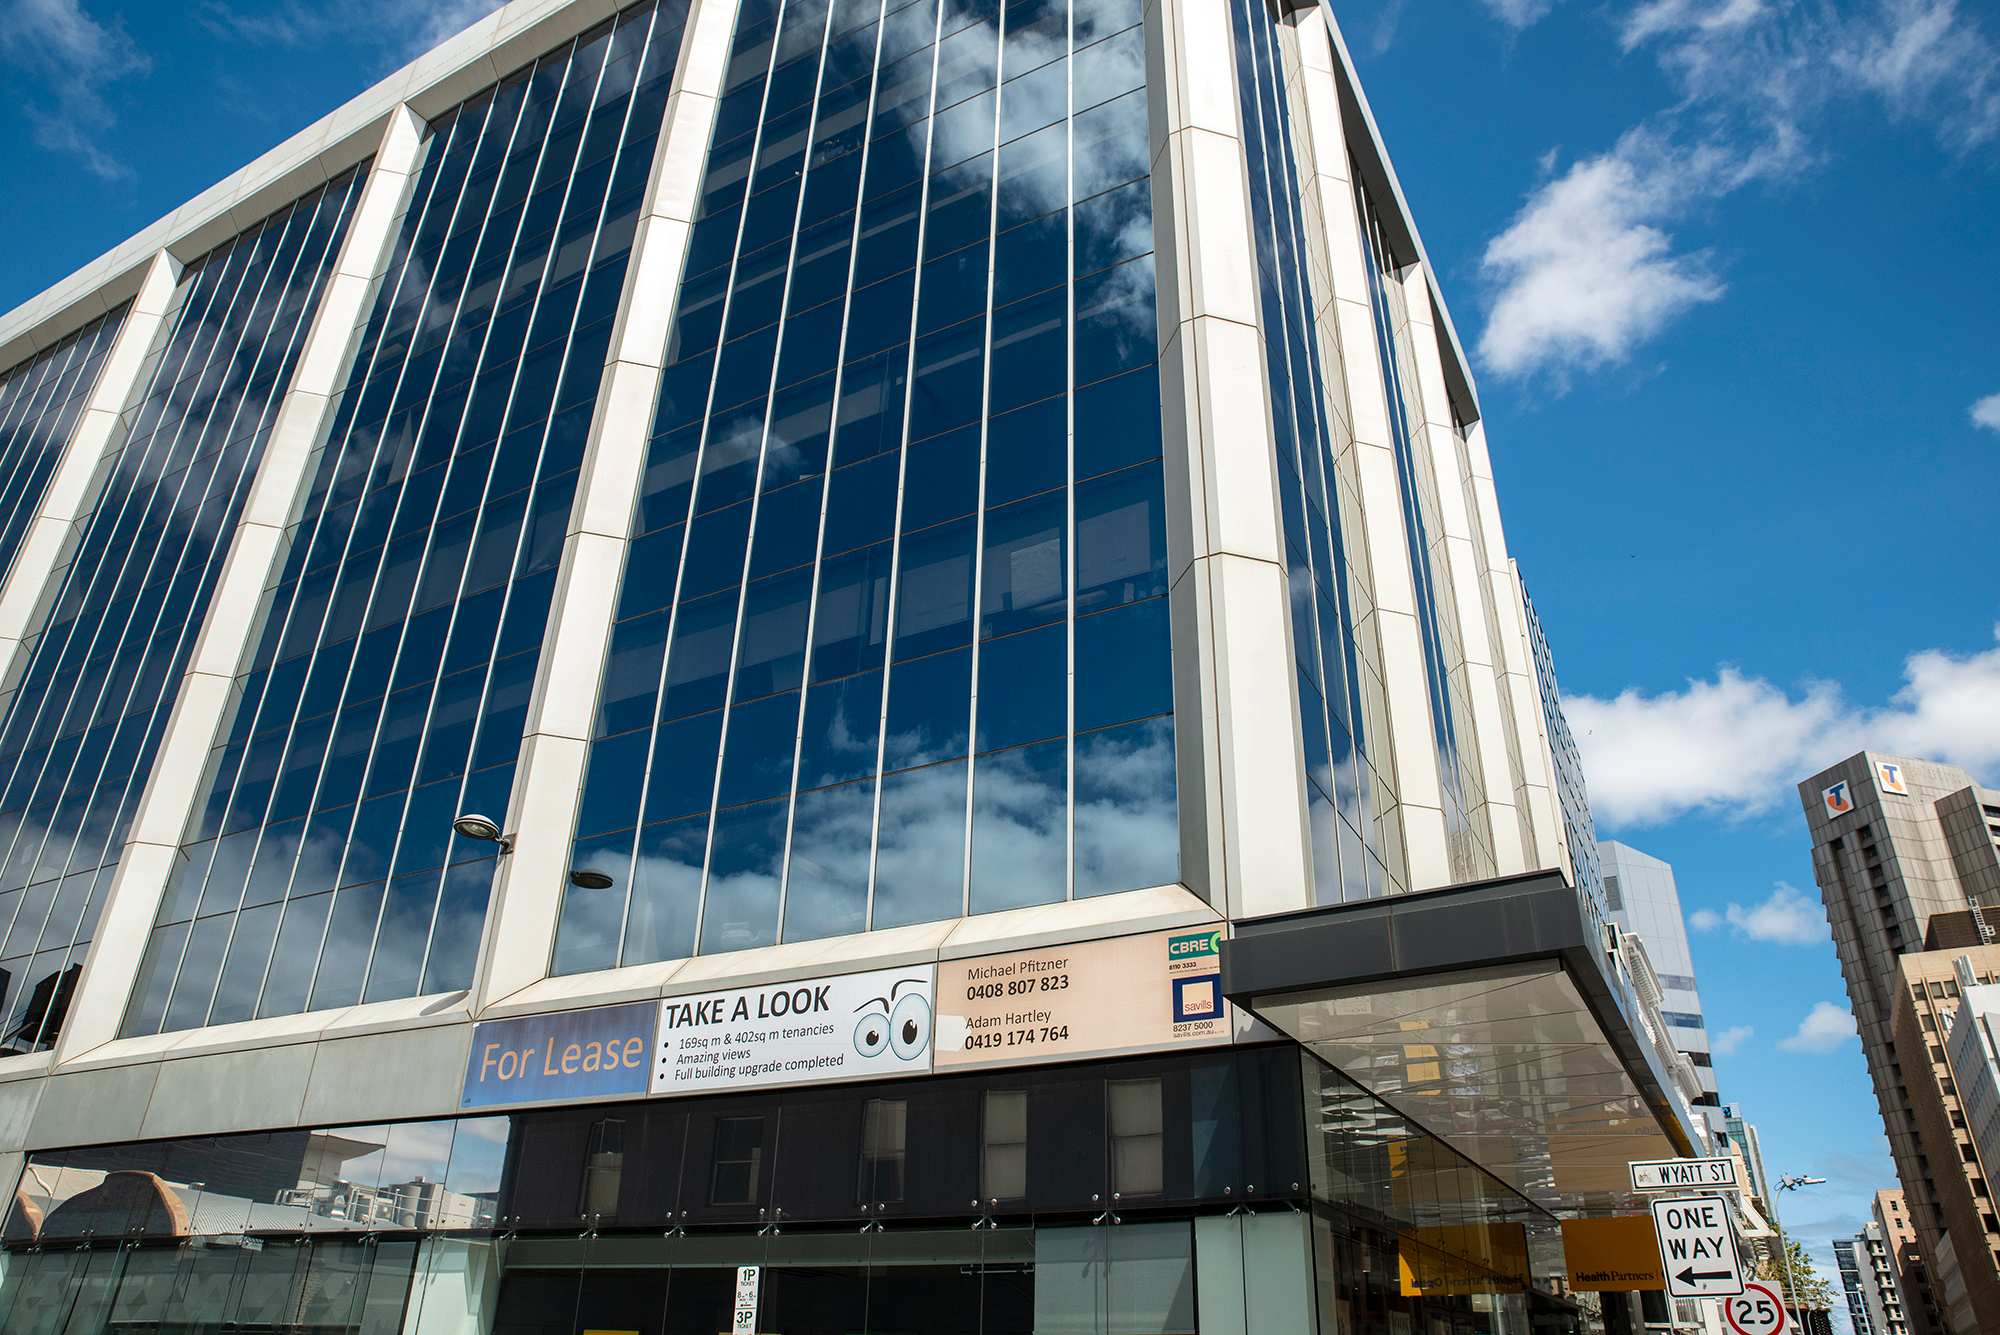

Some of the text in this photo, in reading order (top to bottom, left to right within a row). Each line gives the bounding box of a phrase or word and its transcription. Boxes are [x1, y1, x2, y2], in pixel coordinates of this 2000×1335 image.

[1883, 765, 1898, 784] T
[1829, 782, 1845, 806] T
[1169, 938, 1209, 955] CBRE
[968, 958, 1069, 980] Michael Pfitzner
[1182, 961, 1197, 969] 3333
[966, 974, 1069, 1001] 0408 807 823
[666, 985, 831, 1030] TAKE A LOOK
[1184, 1000, 1213, 1012] savills
[965, 1009, 1052, 1030] Adam Hartley
[1173, 1021, 1214, 1033] 8237 5000
[679, 1023, 834, 1050] 169sq m & 402sq m tenancies
[965, 1025, 1069, 1050] 0419 174 764
[480, 1036, 644, 1082] For Lease
[674, 1053, 845, 1081] Full building upgrade completed
[676, 1049, 751, 1066] Amazing views
[1658, 1163, 1728, 1184] WYATT ST
[1666, 1206, 1718, 1230] ONE
[1667, 1236, 1724, 1260] WAY
[742, 1268, 756, 1281] 1P
[736, 1311, 753, 1324] 3P
[1735, 1300, 1775, 1325] 25
